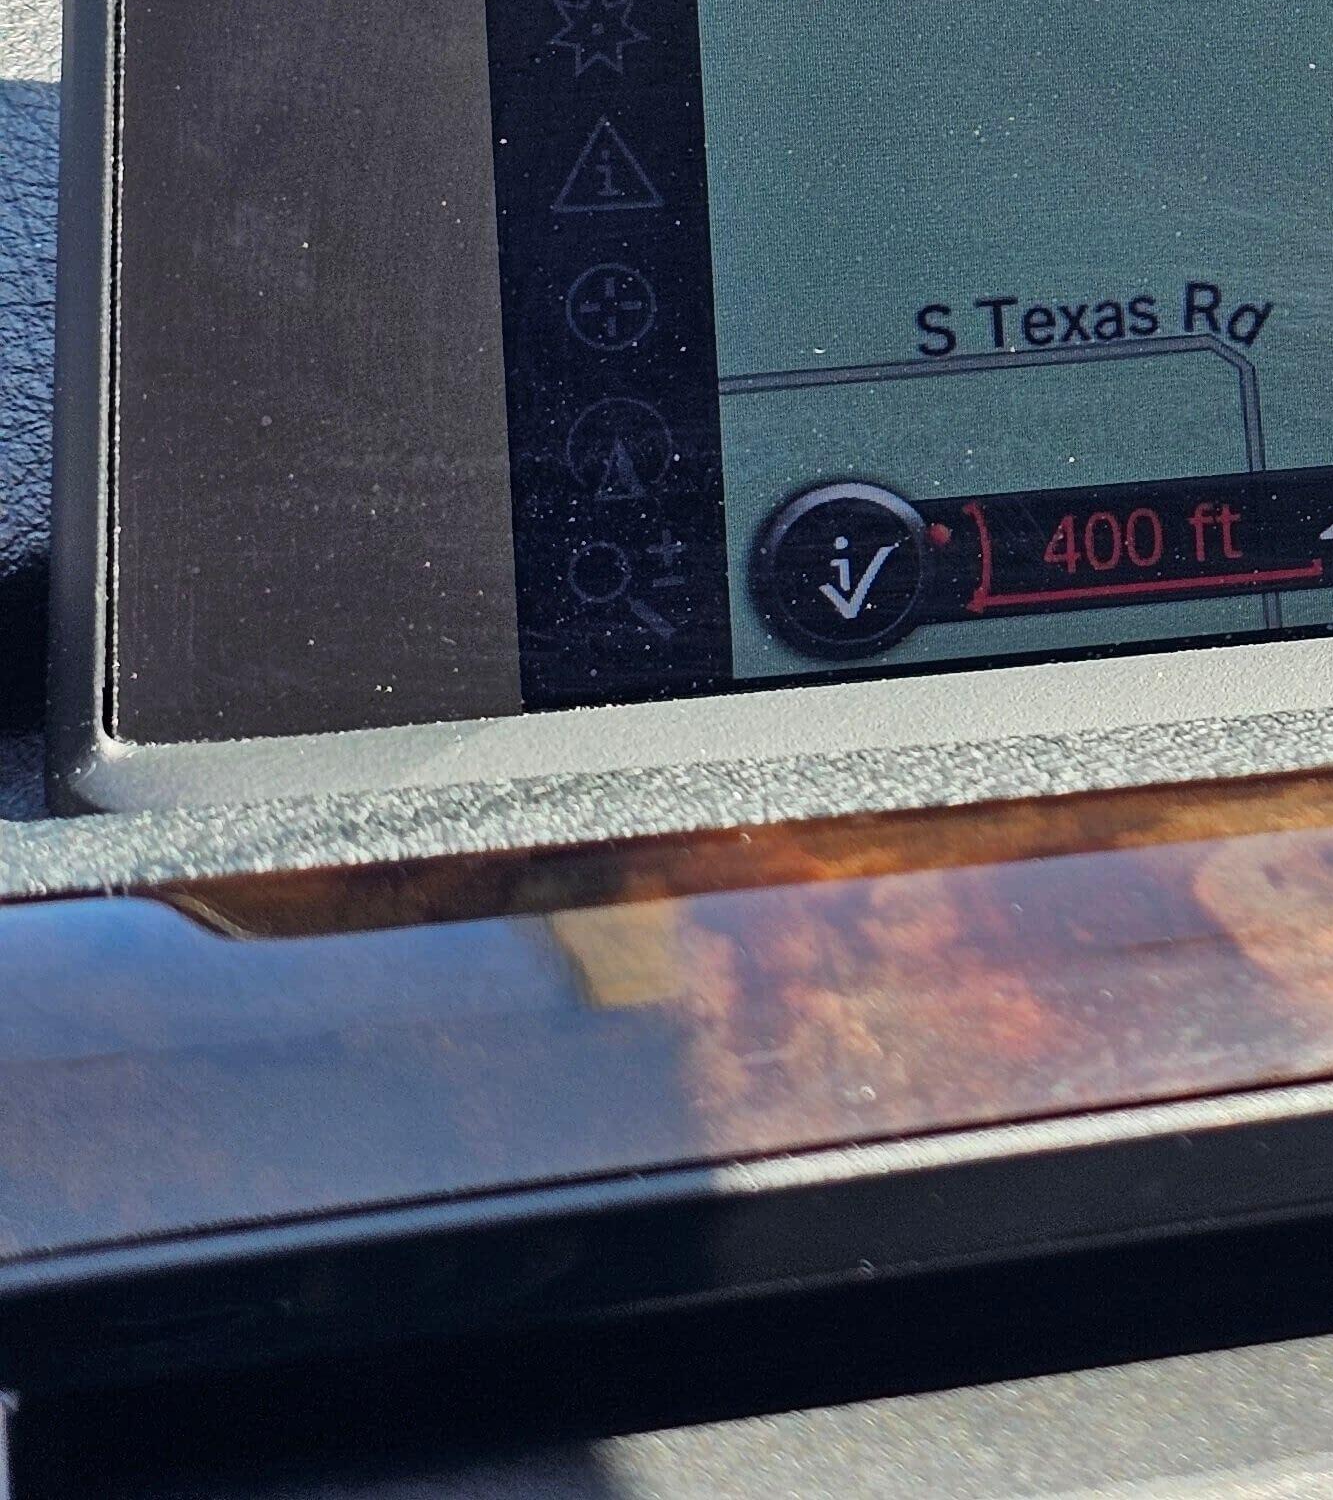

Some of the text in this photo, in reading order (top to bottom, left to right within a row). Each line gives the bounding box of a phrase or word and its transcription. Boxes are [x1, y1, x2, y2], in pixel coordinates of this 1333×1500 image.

[917, 282, 1273, 356] S Texas Rd
[1044, 504, 1241, 573] 400 ft
